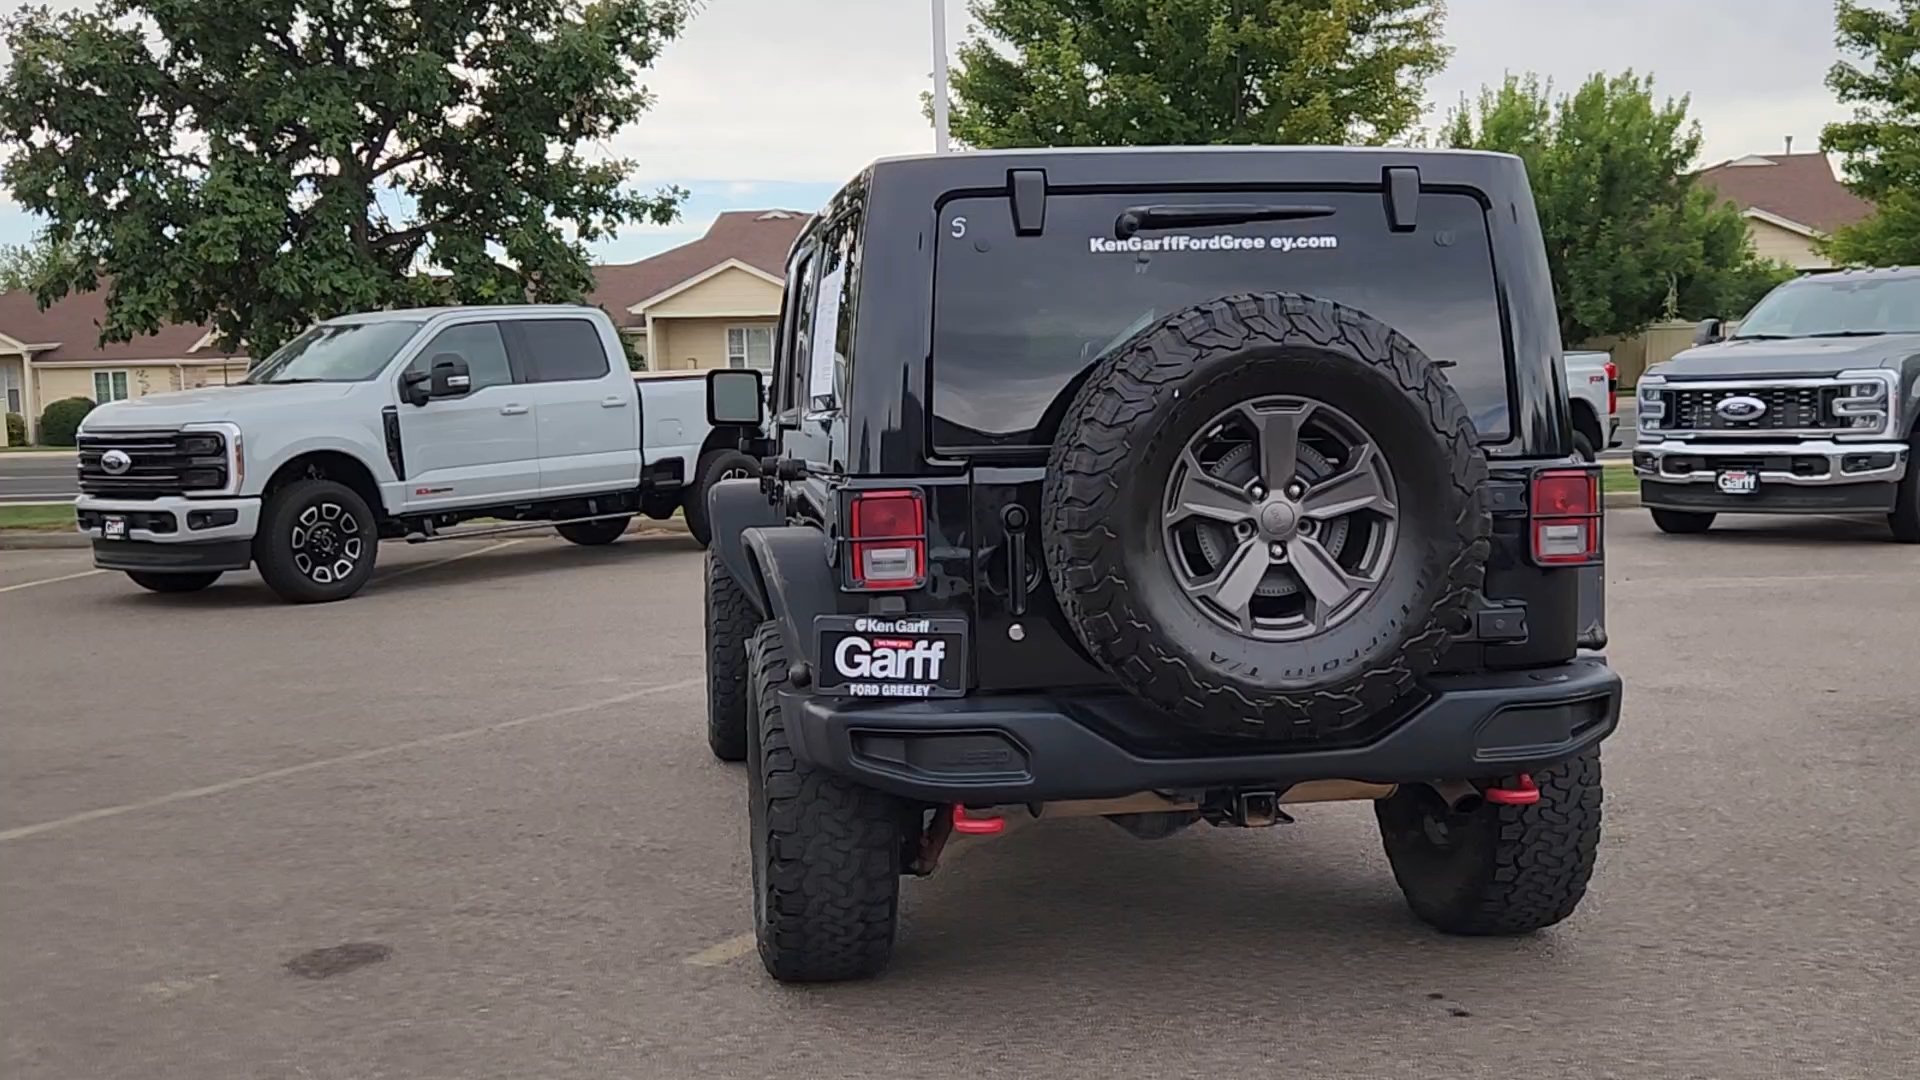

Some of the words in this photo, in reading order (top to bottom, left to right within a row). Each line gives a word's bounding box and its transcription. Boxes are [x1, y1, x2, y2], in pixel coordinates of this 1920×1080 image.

[868, 619, 894, 633] Ken
[896, 620, 929, 633] Garff
[835, 636, 945, 680] Garff
[850, 684, 878, 697] FORD
[882, 684, 929, 697] GREELEY
